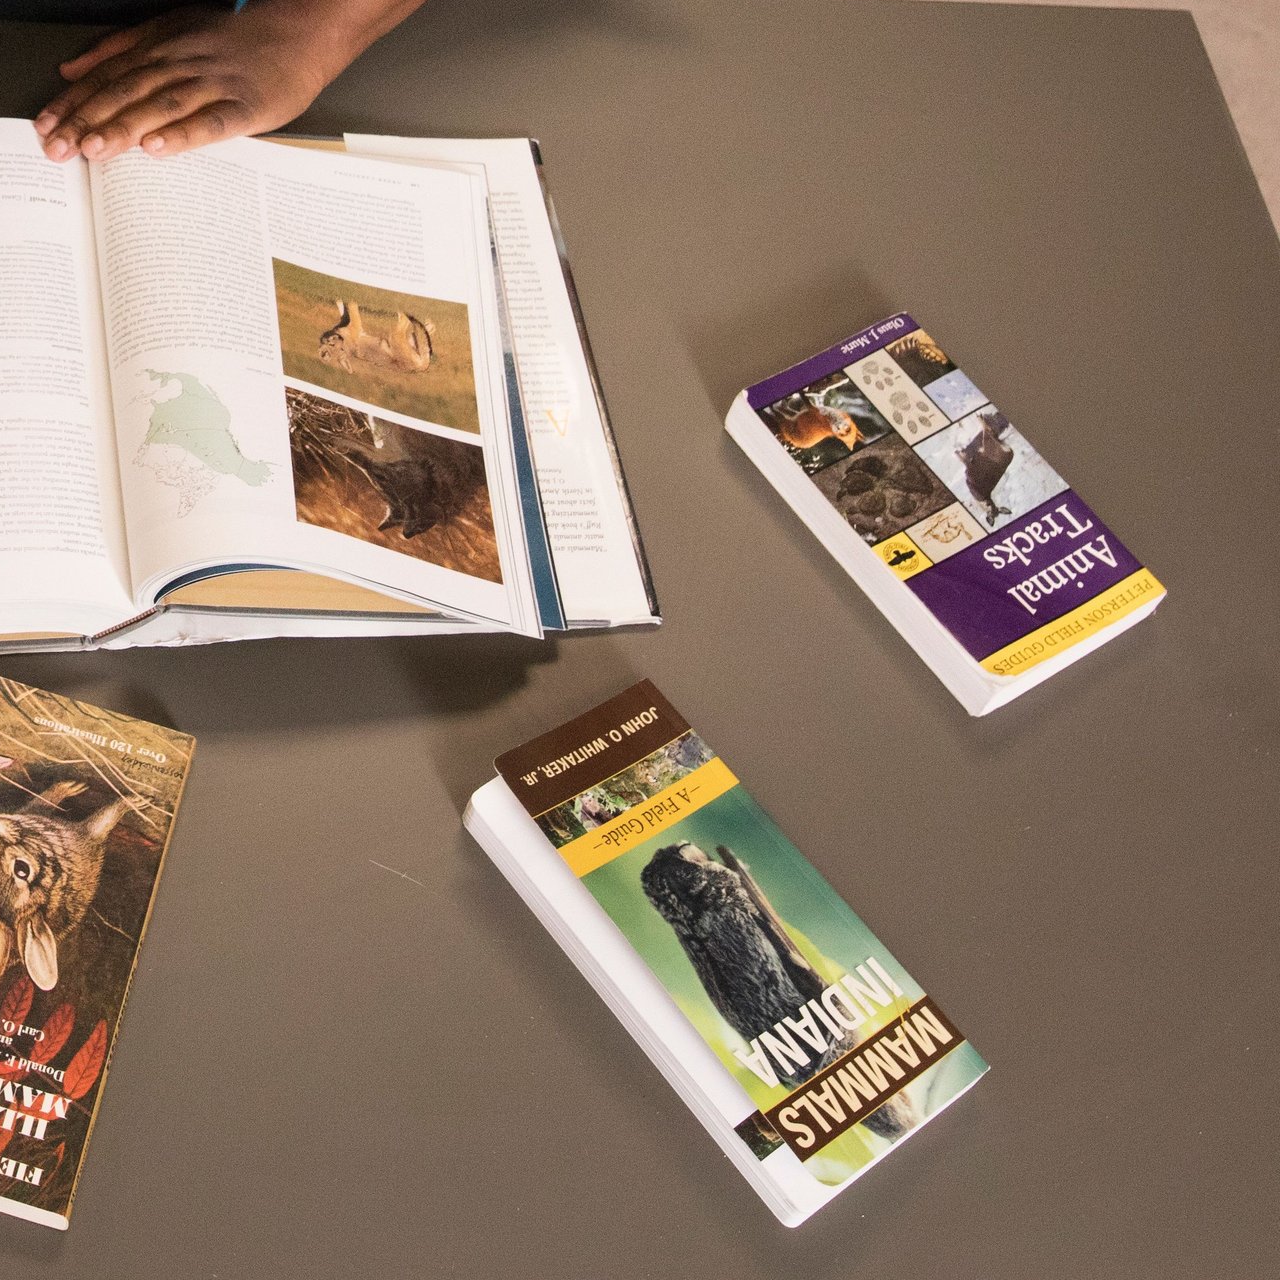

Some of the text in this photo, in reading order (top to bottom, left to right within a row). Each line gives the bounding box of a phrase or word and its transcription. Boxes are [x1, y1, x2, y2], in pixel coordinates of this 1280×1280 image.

[839, 316, 905, 355] Olaus J. Murie
[579, 497, 596, 506] facts
[983, 502, 1094, 571] Tracks
[1005, 533, 1118, 616] Animal
[990, 576, 1154, 676] PETERSON FIELD GUIDES
[32, 714, 167, 763] Over 120 Illustrations
[518, 704, 658, 787] JOHN O. WHITAKER, JR.
[640, 794, 678, 828] Field
[16, 1023, 46, 1042] Carl
[730, 954, 904, 1089] INDIANA
[3, 1051, 17, 1066] F.
[16, 1055, 66, 1083] Donald
[773, 1004, 953, 1152] MAMMALS
